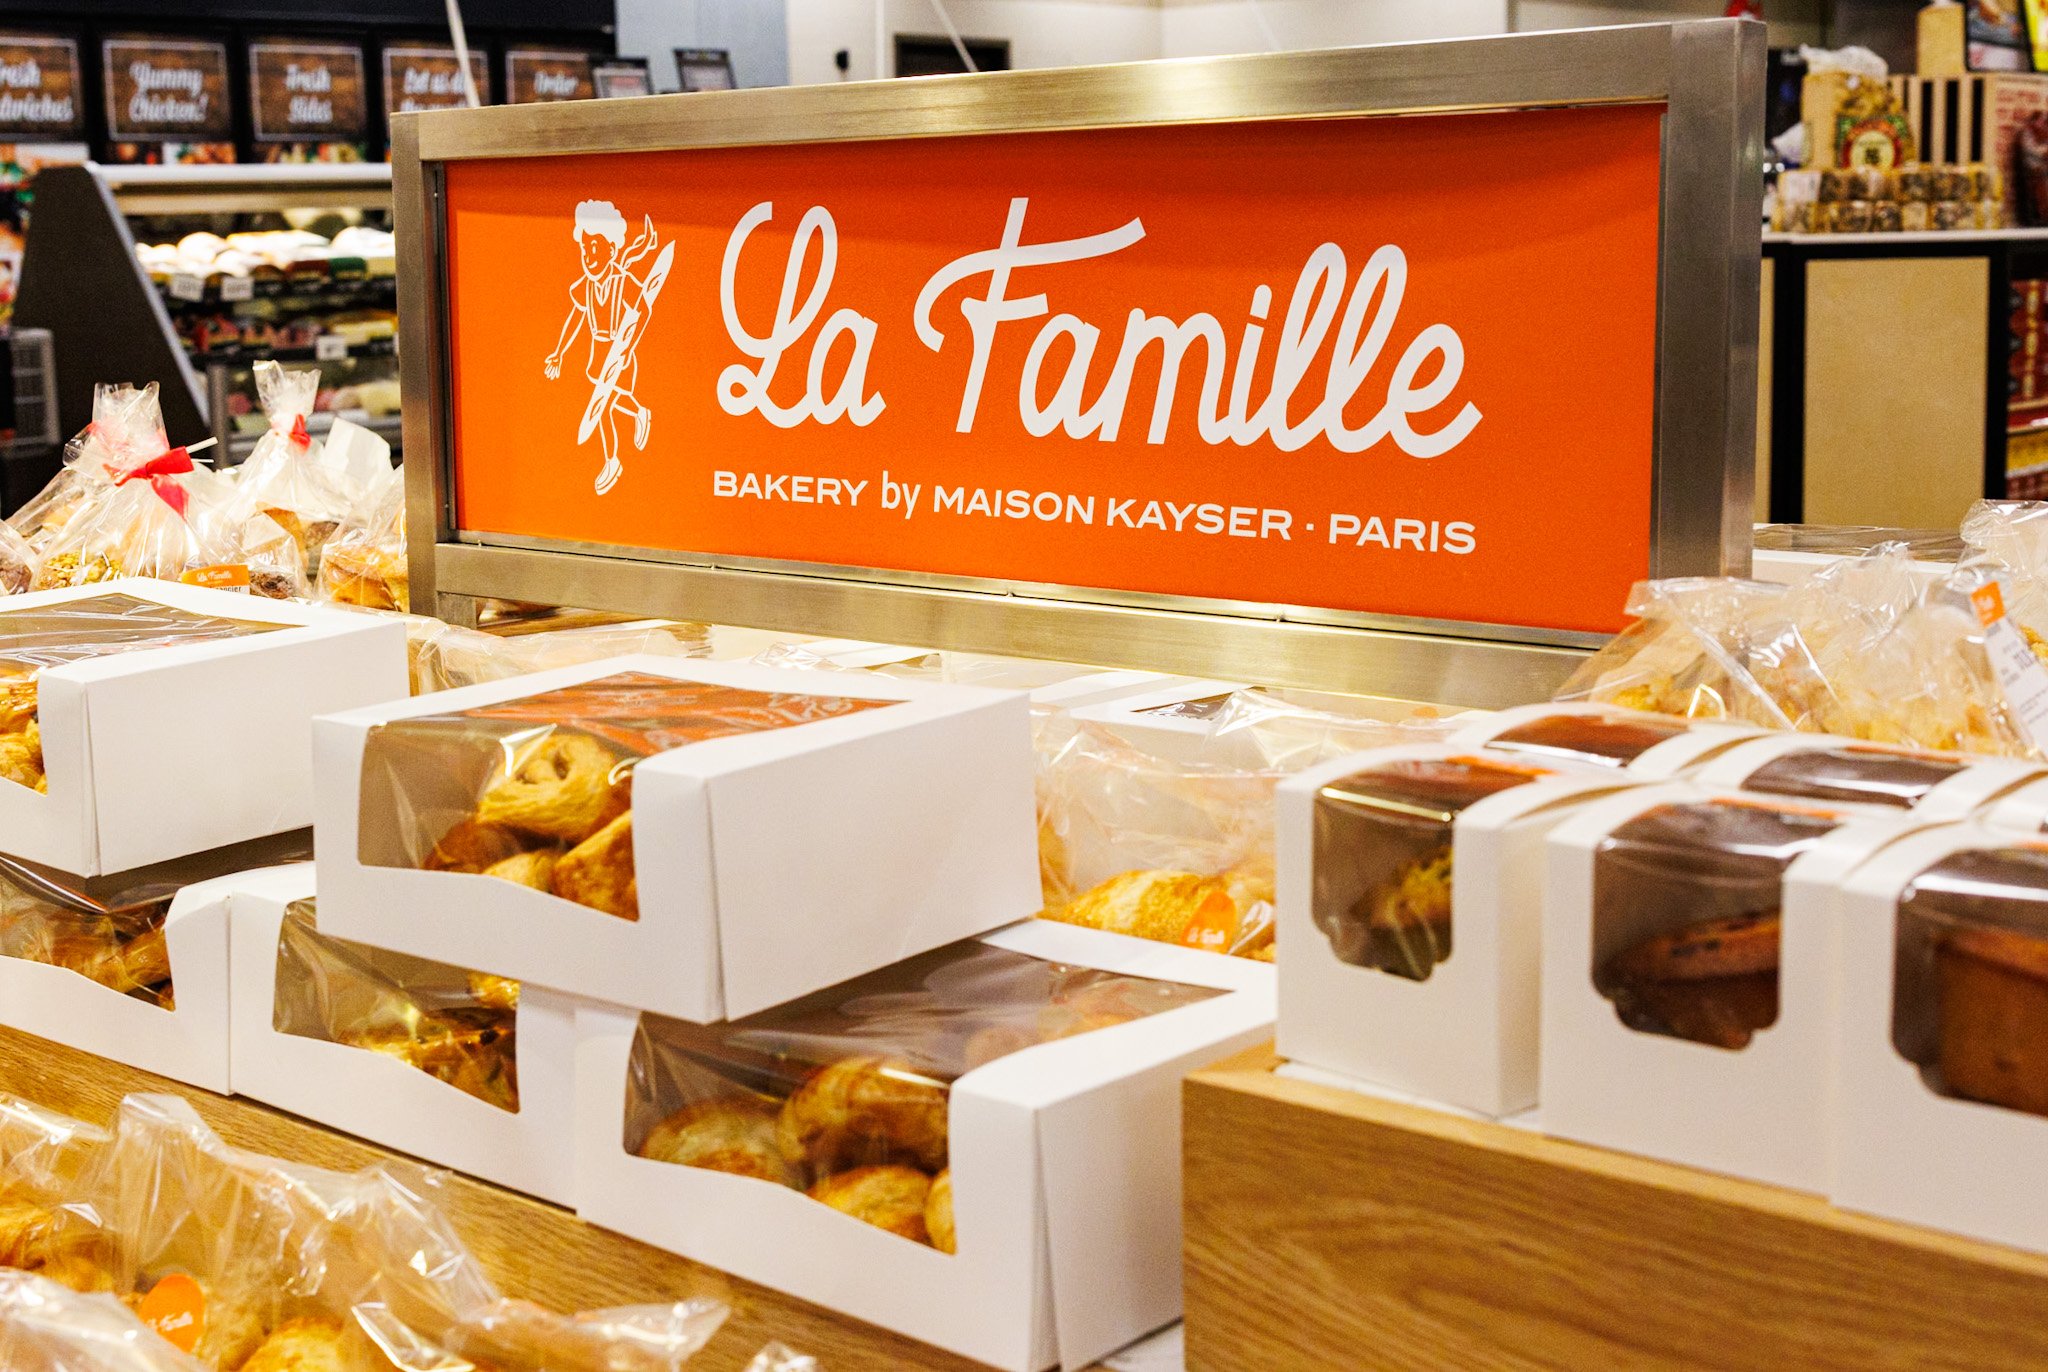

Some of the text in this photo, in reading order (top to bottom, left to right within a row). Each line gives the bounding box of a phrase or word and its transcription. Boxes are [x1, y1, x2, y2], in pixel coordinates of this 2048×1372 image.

[129, 61, 203, 98] Yummy
[129, 94, 208, 122] Chicken!
[717, 198, 1482, 458] La Famille
[714, 470, 1475, 554] BAKERY by MAISON KAYSER PARIS
